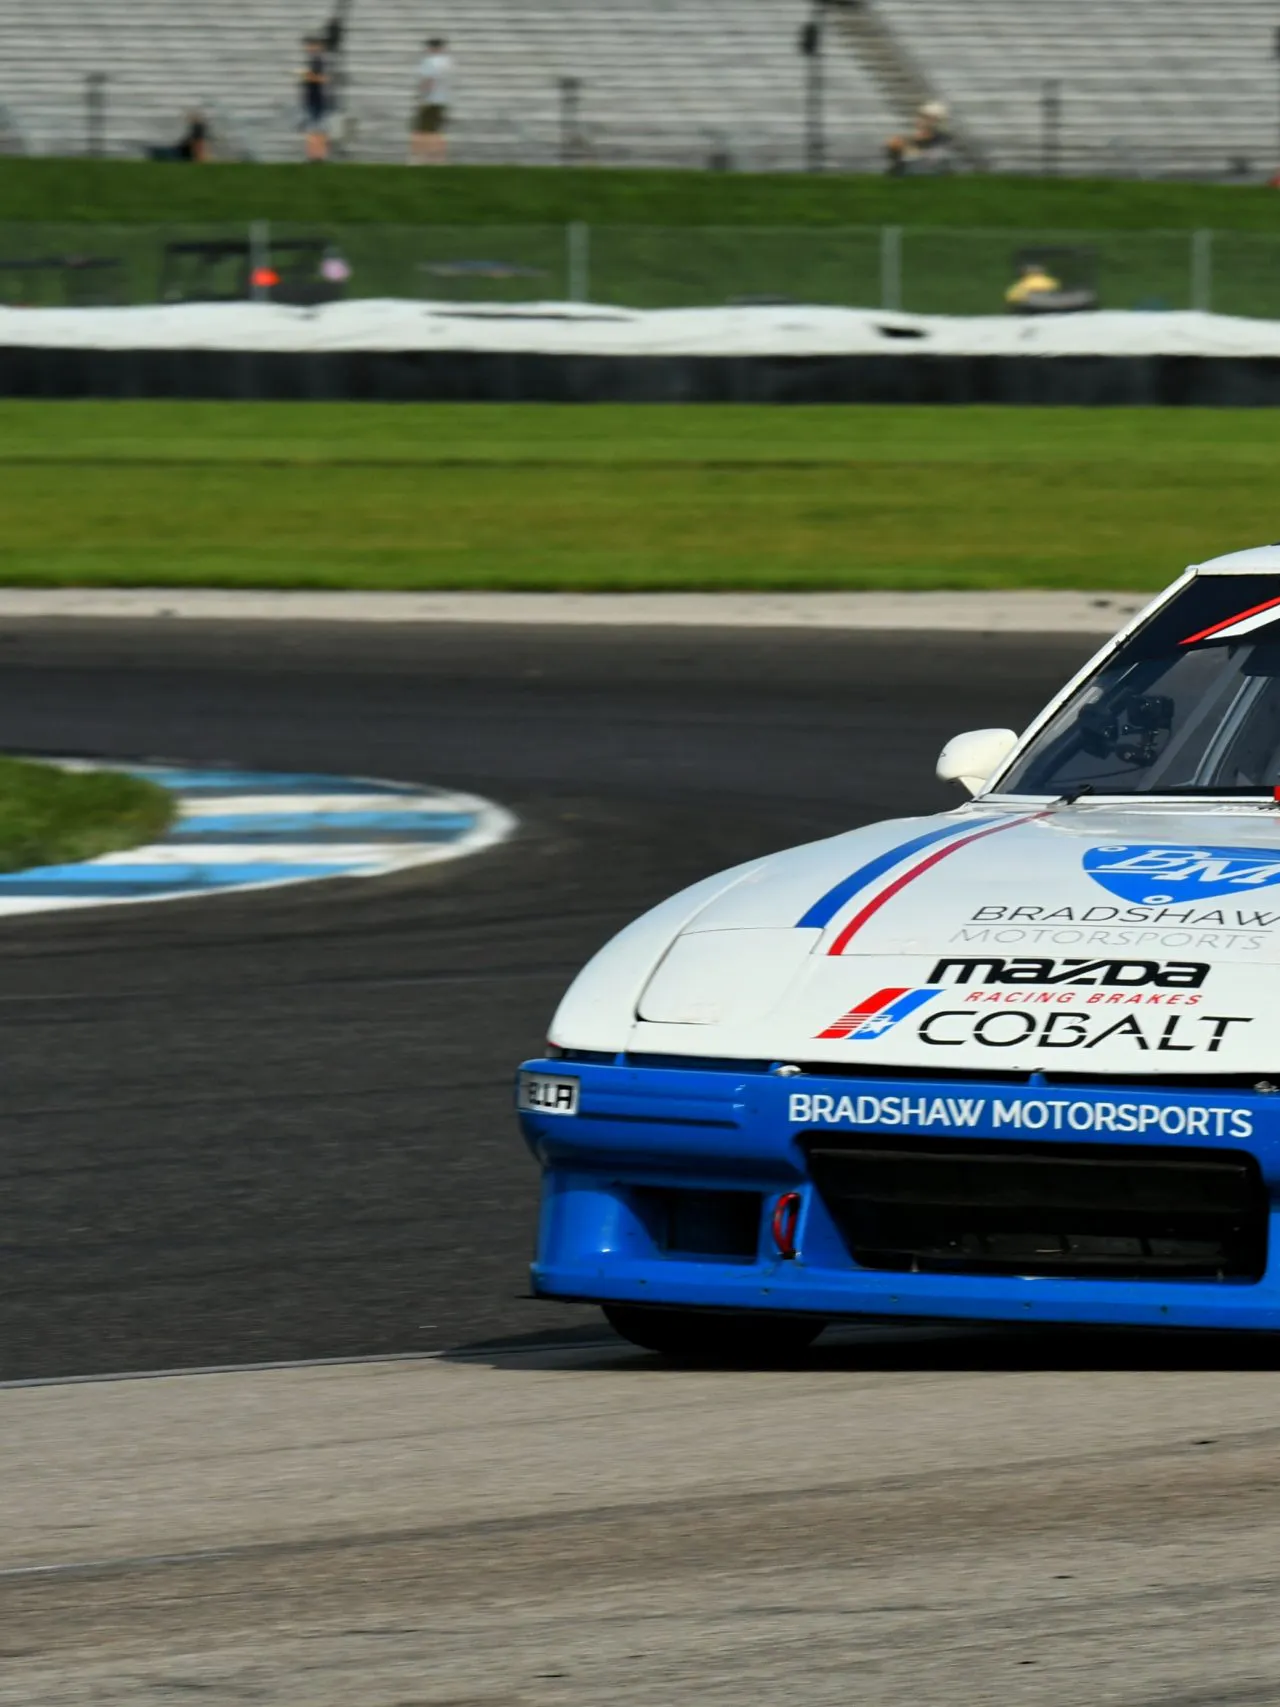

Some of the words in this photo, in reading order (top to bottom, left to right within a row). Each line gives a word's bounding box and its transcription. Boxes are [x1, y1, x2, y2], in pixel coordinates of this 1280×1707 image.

[949, 929, 1267, 951] MOTORSPORTS
[964, 991, 1074, 1004] RACING
[1086, 993, 1204, 1006] BRAKES
[917, 1010, 1254, 1052] COBALT
[788, 1094, 985, 1128] BRADSHAW
[992, 1100, 1254, 1139] MOTORSPORTS
